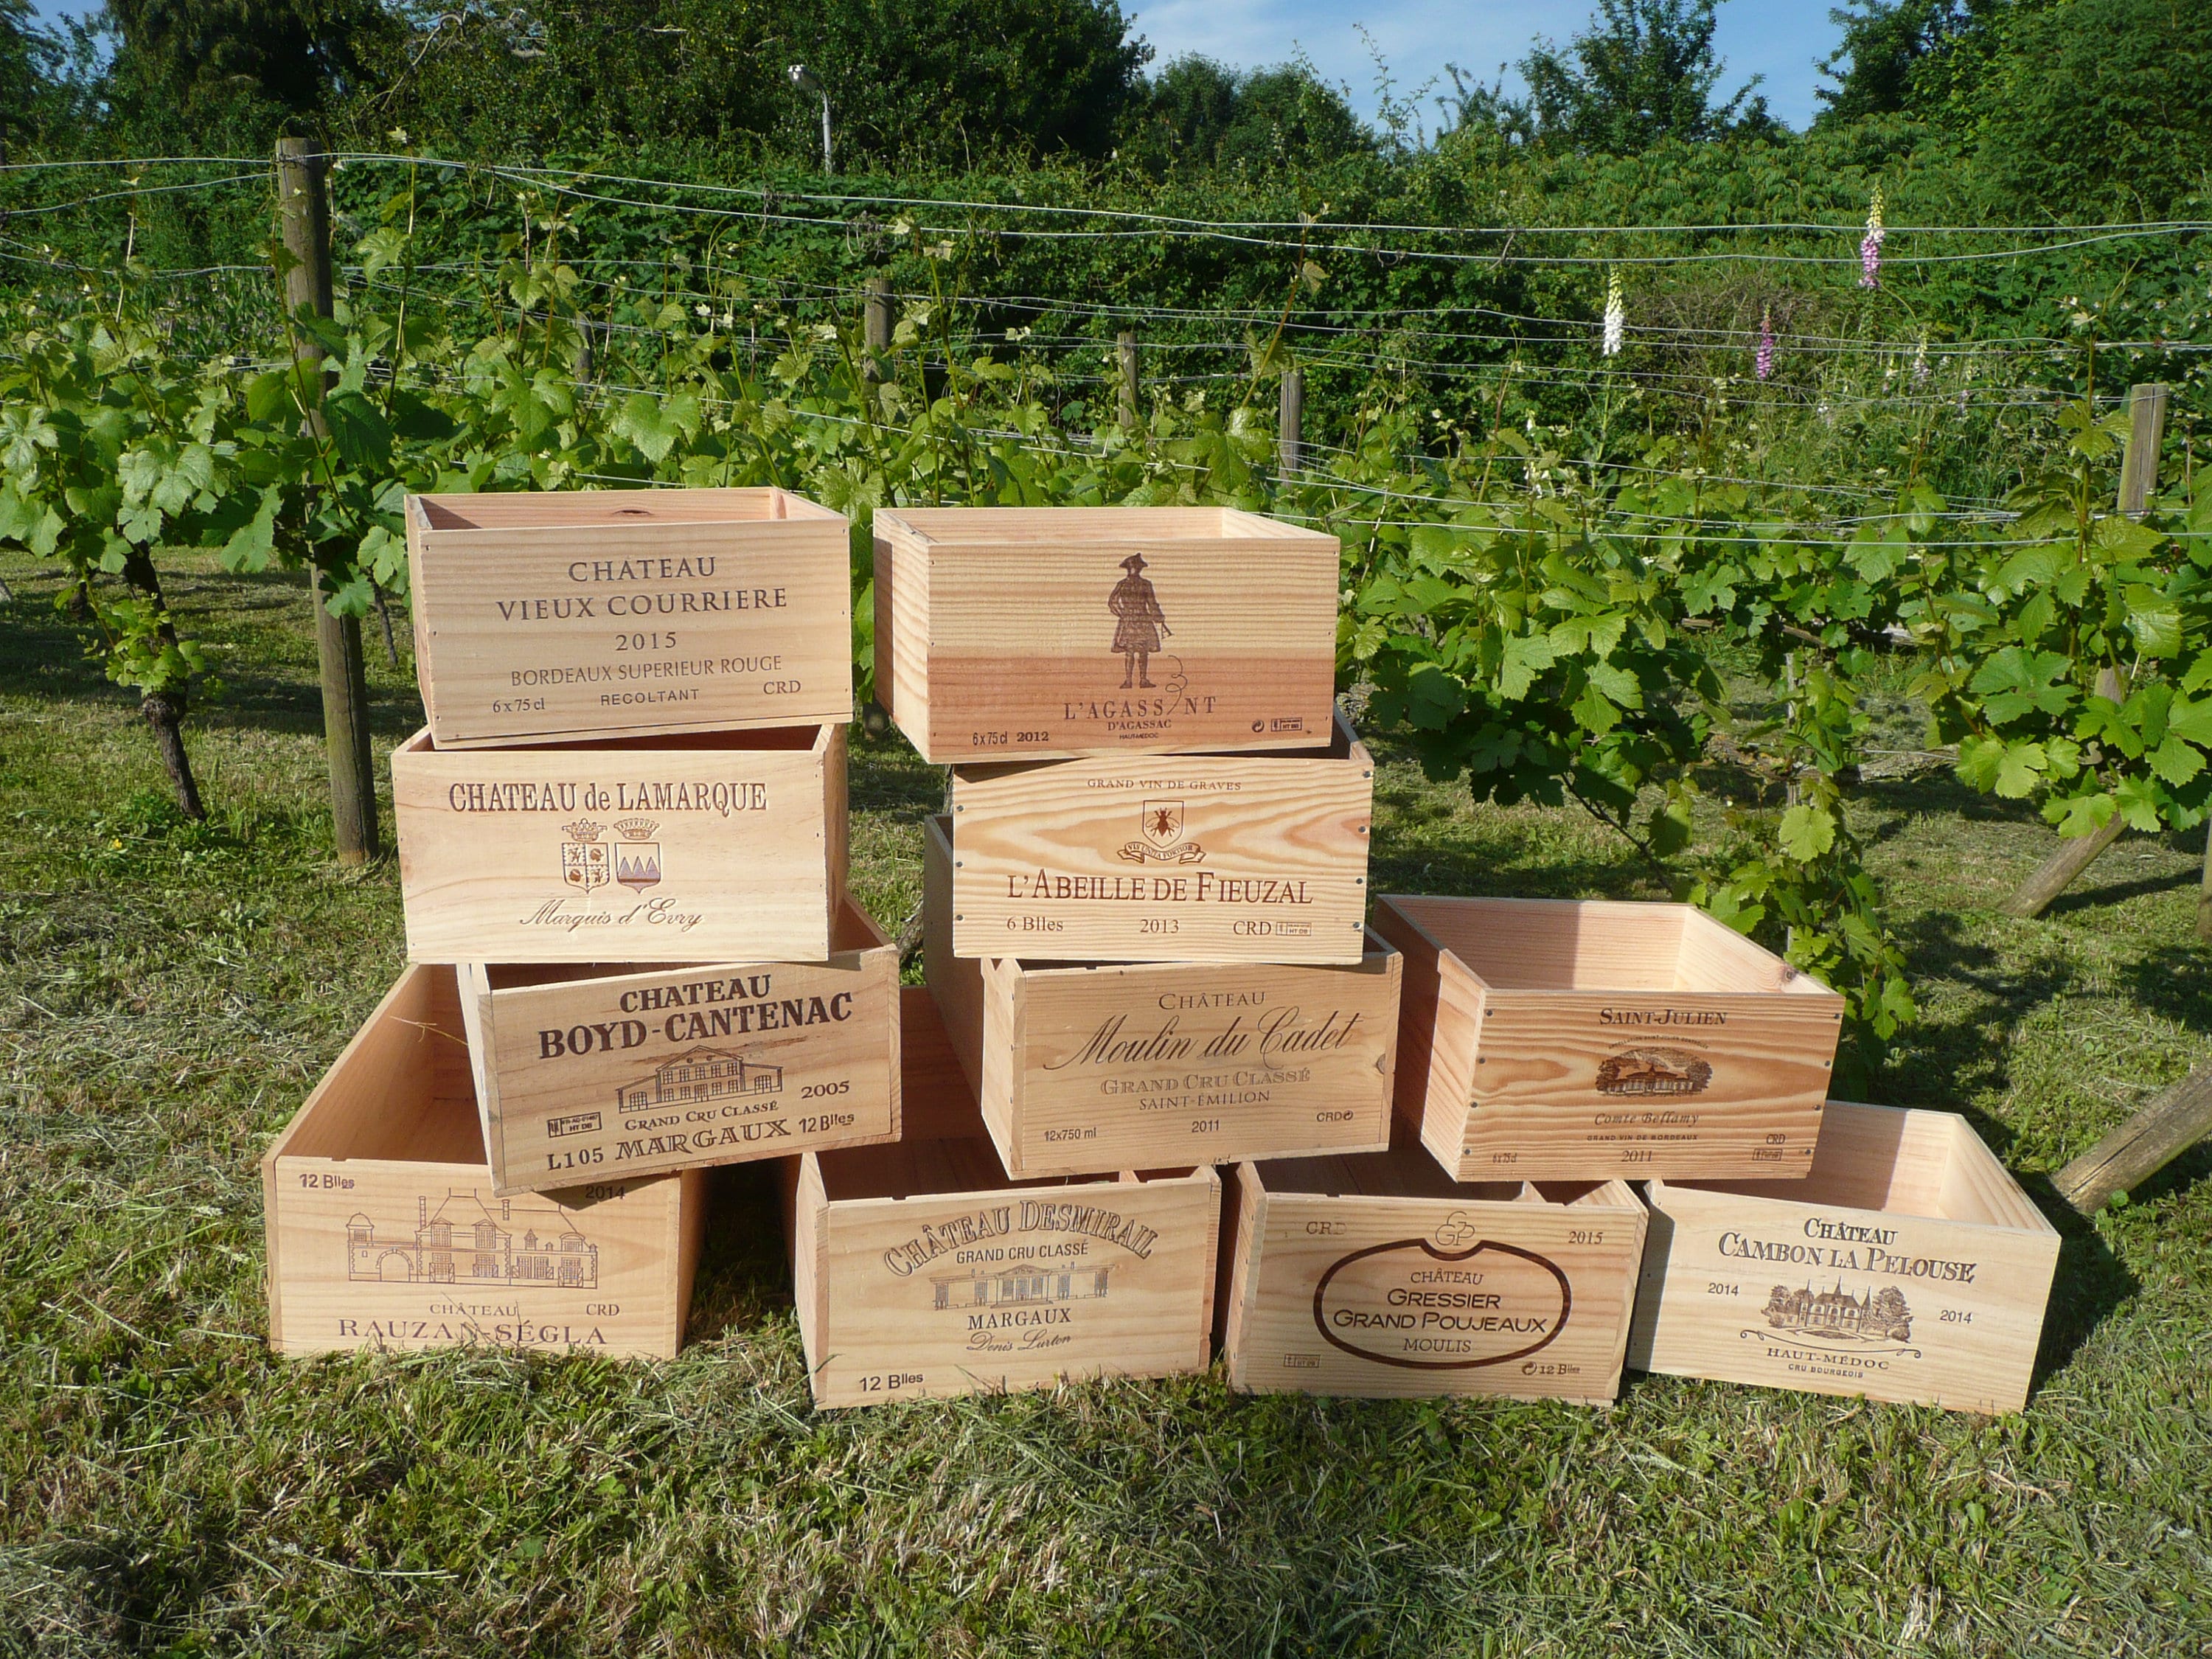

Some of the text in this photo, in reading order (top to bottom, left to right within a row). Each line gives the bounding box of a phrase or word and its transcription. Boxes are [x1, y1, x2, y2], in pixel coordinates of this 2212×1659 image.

[568, 556, 716, 582] CHATEAU
[496, 588, 787, 621] VIEUX COURRIERE
[615, 631, 678, 650] 2015
[512, 655, 782, 686] BORDEAUX SUPERIEUR ROUGE
[763, 680, 801, 695] CRD
[601, 689, 700, 706] RECOLTANT
[1107, 719, 1172, 731] D'AGASSAC
[1017, 731, 1048, 742] 2012
[1088, 779, 1242, 791] GRAND VIN DE GRAVES
[450, 782, 767, 817] CHATEAU de LAMARQUE
[1008, 869, 1313, 904] L'ABEILLE DE FIEUZAL
[520, 899, 611, 932] Marquis
[1007, 917, 1063, 932] 6 Blles
[1140, 919, 1180, 934] 2013
[1233, 920, 1271, 935] CRD
[619, 974, 771, 1014] CHATEAU
[1158, 992, 1266, 1010] CHÂTEAU
[539, 992, 853, 1060] BOYD-CANTENAC
[1599, 1008, 1728, 1026] SAINT-JULIEN
[1043, 1006, 1364, 1071] Moulin du Cadet
[801, 1080, 850, 1099] 2005
[1101, 1067, 1311, 1096] GRAND CRU CLASSÉ
[625, 1099, 779, 1131] GRAND CRU CLASSÉ
[1317, 1111, 1343, 1122] CRD
[1084, 1127, 1096, 1139] ml
[1192, 1119, 1220, 1133] 2011
[547, 1147, 605, 1171] L105
[615, 1119, 791, 1161] MARGAUX
[799, 1117, 817, 1133] 12
[820, 1113, 855, 1131] Blles
[1766, 1133, 1786, 1145] CRD
[1621, 1150, 1653, 1162] 2011
[299, 1174, 319, 1188] 12
[585, 1184, 625, 1200] 2014
[1306, 1221, 1347, 1235] CRD
[1804, 1217, 1898, 1245] CHÂTEAU
[883, 1200, 1158, 1277] CHÂTEAU DESMIRAIL
[1568, 1230, 1603, 1245] 2015
[956, 1242, 1089, 1265] GRAND CRU CLASSÉ
[1719, 1232, 1977, 1284] CAMBON LA PELOUSE
[1410, 1267, 1484, 1286] CHÂTEAU
[1387, 1288, 1501, 1309] GRESSIER
[1708, 1282, 1739, 1297] 2014
[430, 1302, 517, 1316] CHÂTEAU
[586, 1304, 619, 1317] CRD
[1939, 1309, 1972, 1325] 2014
[967, 1308, 1072, 1330] MARGAUX
[1333, 1309, 1548, 1333] GRAND POUJEAUX
[966, 1329, 1071, 1352] Denis Lurton
[1402, 1338, 1472, 1353] MOULIS
[1539, 1365, 1554, 1374] 12
[1788, 1363, 1864, 1379] CRU BOURGEOIS
[860, 1371, 924, 1392] 12 Blles
